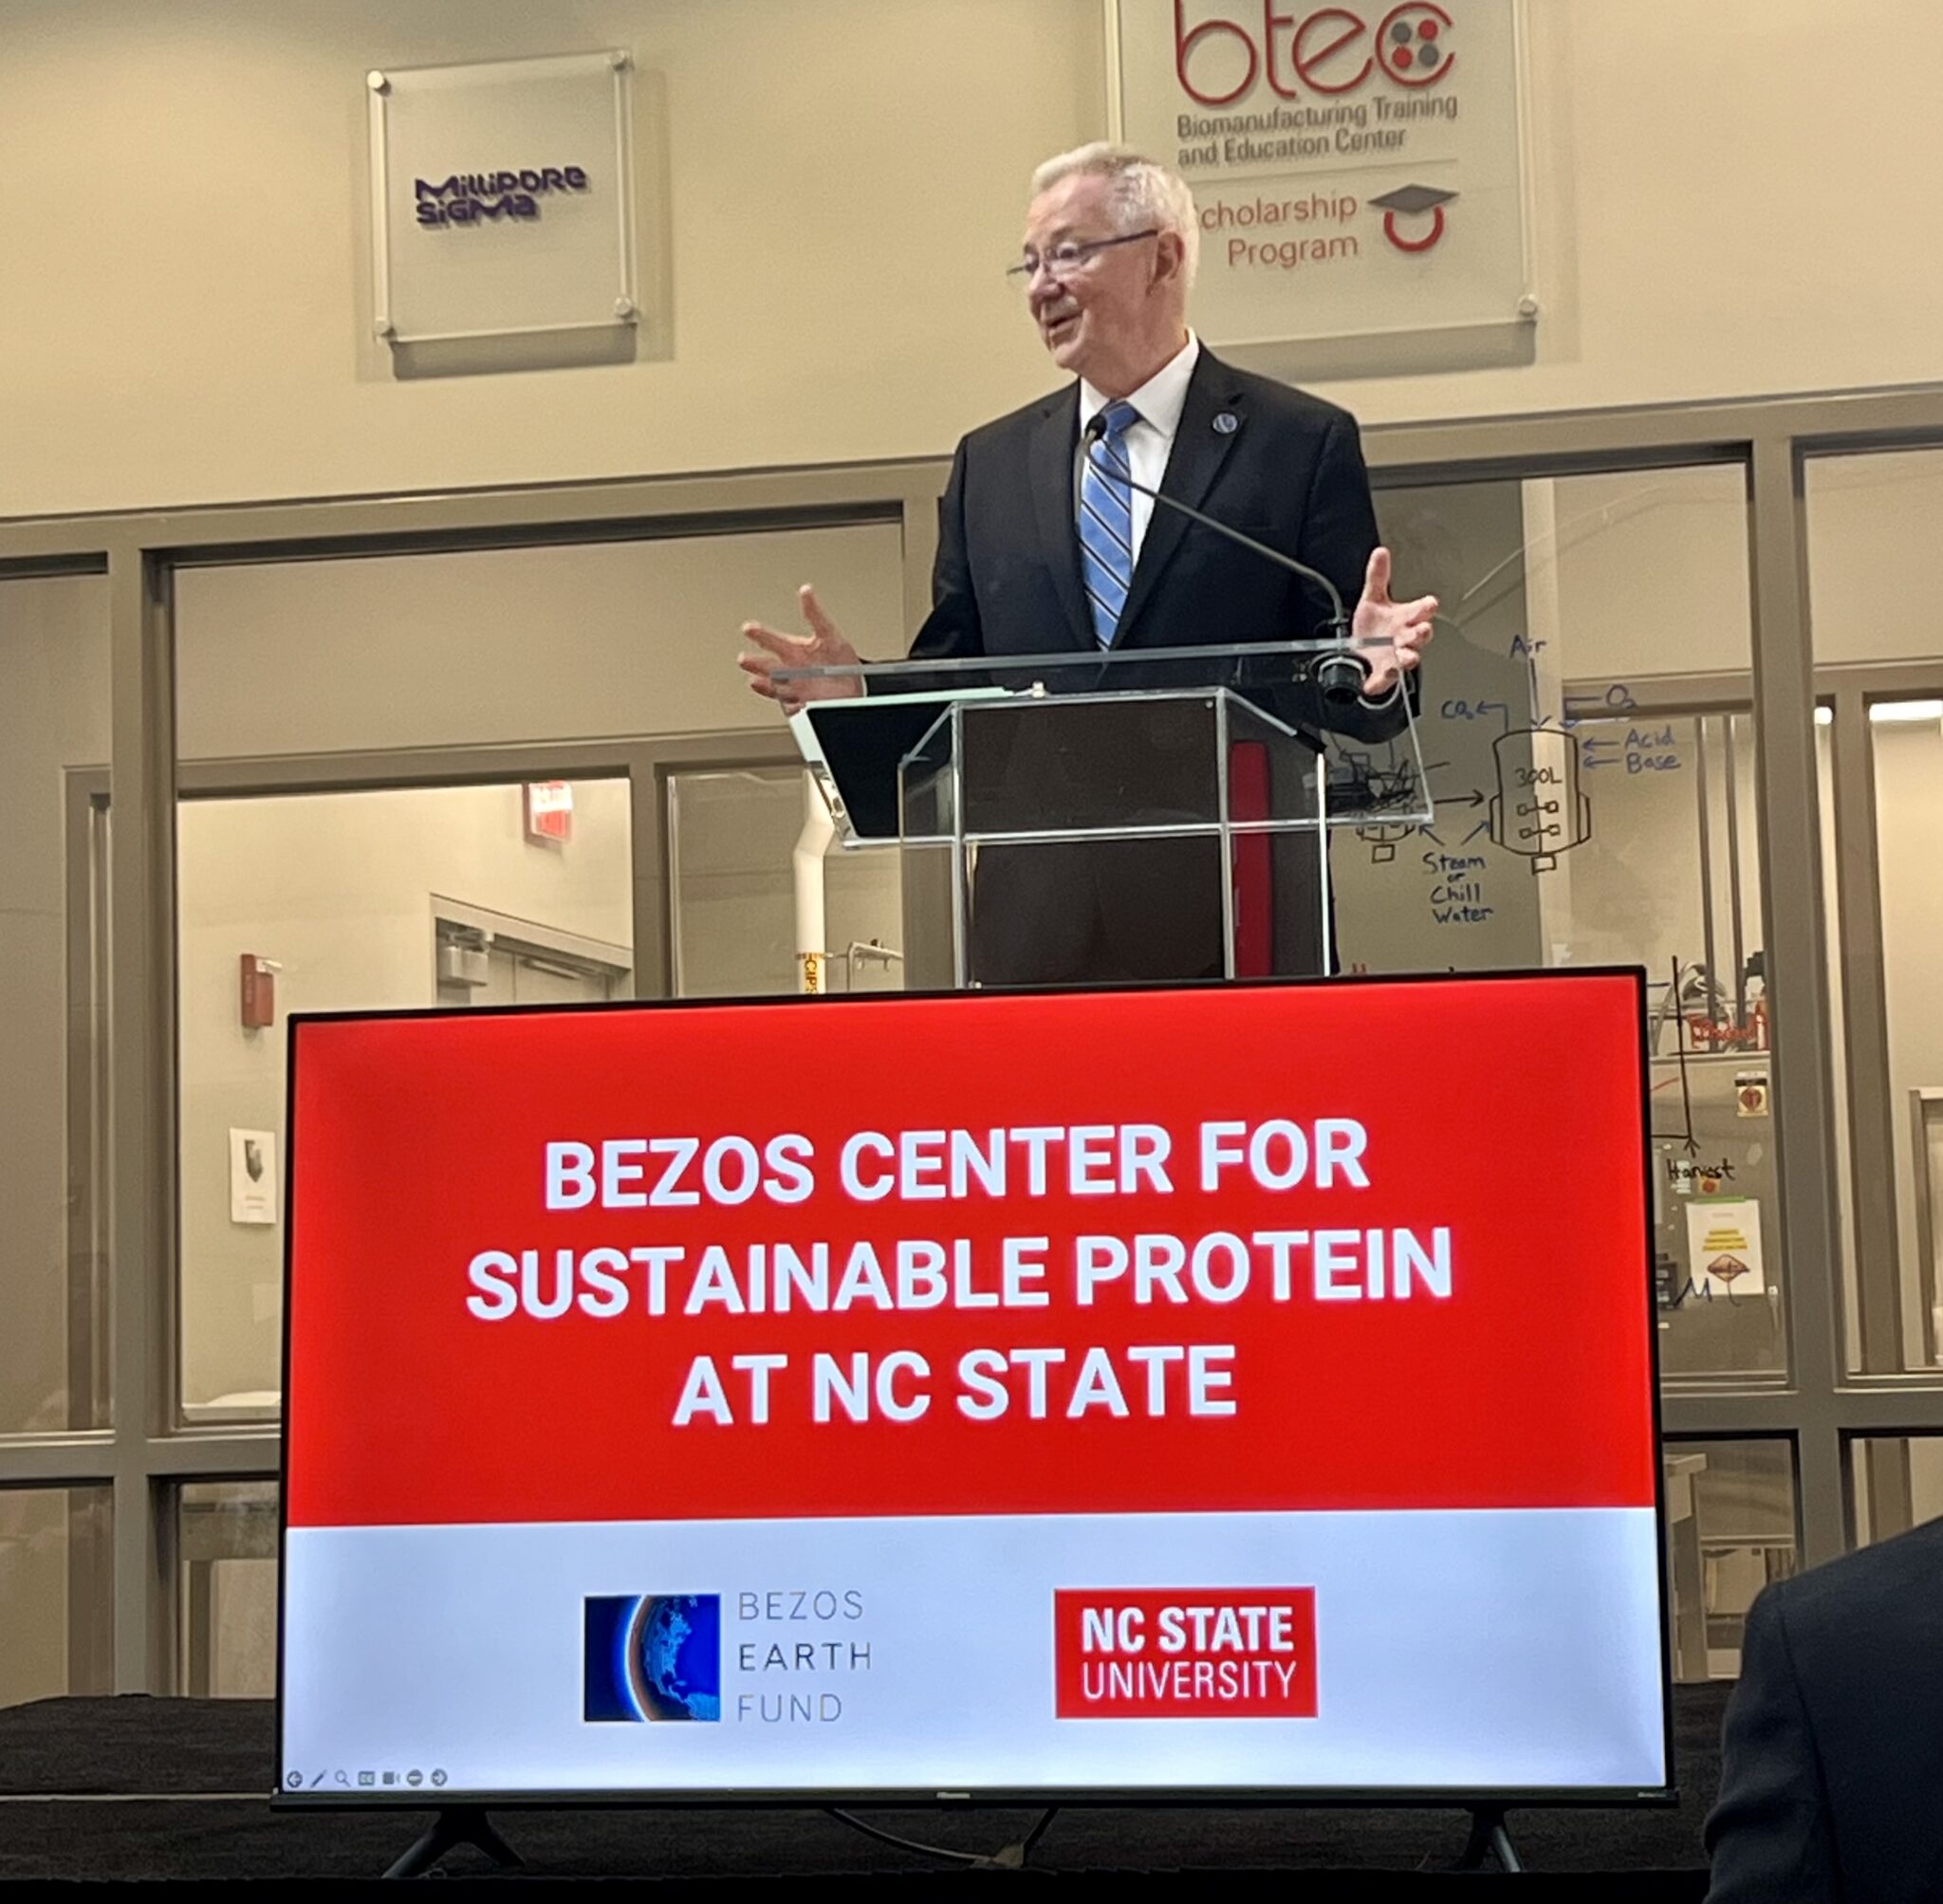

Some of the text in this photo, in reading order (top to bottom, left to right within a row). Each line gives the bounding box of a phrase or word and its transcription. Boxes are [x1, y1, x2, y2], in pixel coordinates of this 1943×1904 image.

[1176, 92, 1458, 139] Biomanufacturing Training
[1177, 127, 1407, 168] and Education Center
[1194, 191, 1359, 231] cholarship
[1228, 234, 1360, 269] Program
[1509, 635, 1546, 659] Air
[1624, 725, 1675, 748] Acid
[1626, 752, 1681, 774] Base
[1422, 852, 1487, 875] Steam
[1431, 883, 1481, 904] Chill
[1431, 906, 1495, 924] Water
[546, 1118, 1371, 1210] BEZOS CENTER FOR
[466, 1227, 1453, 1321] SUSTAINABLE PROTEIN
[672, 1344, 1237, 1426] AT NC STATE
[738, 1589, 864, 1621] BEZOS
[1082, 1606, 1294, 1654] NC STATE
[738, 1642, 872, 1673] EARTH
[1083, 1660, 1297, 1700] UNIVERSITY
[737, 1693, 843, 1723] FUND
